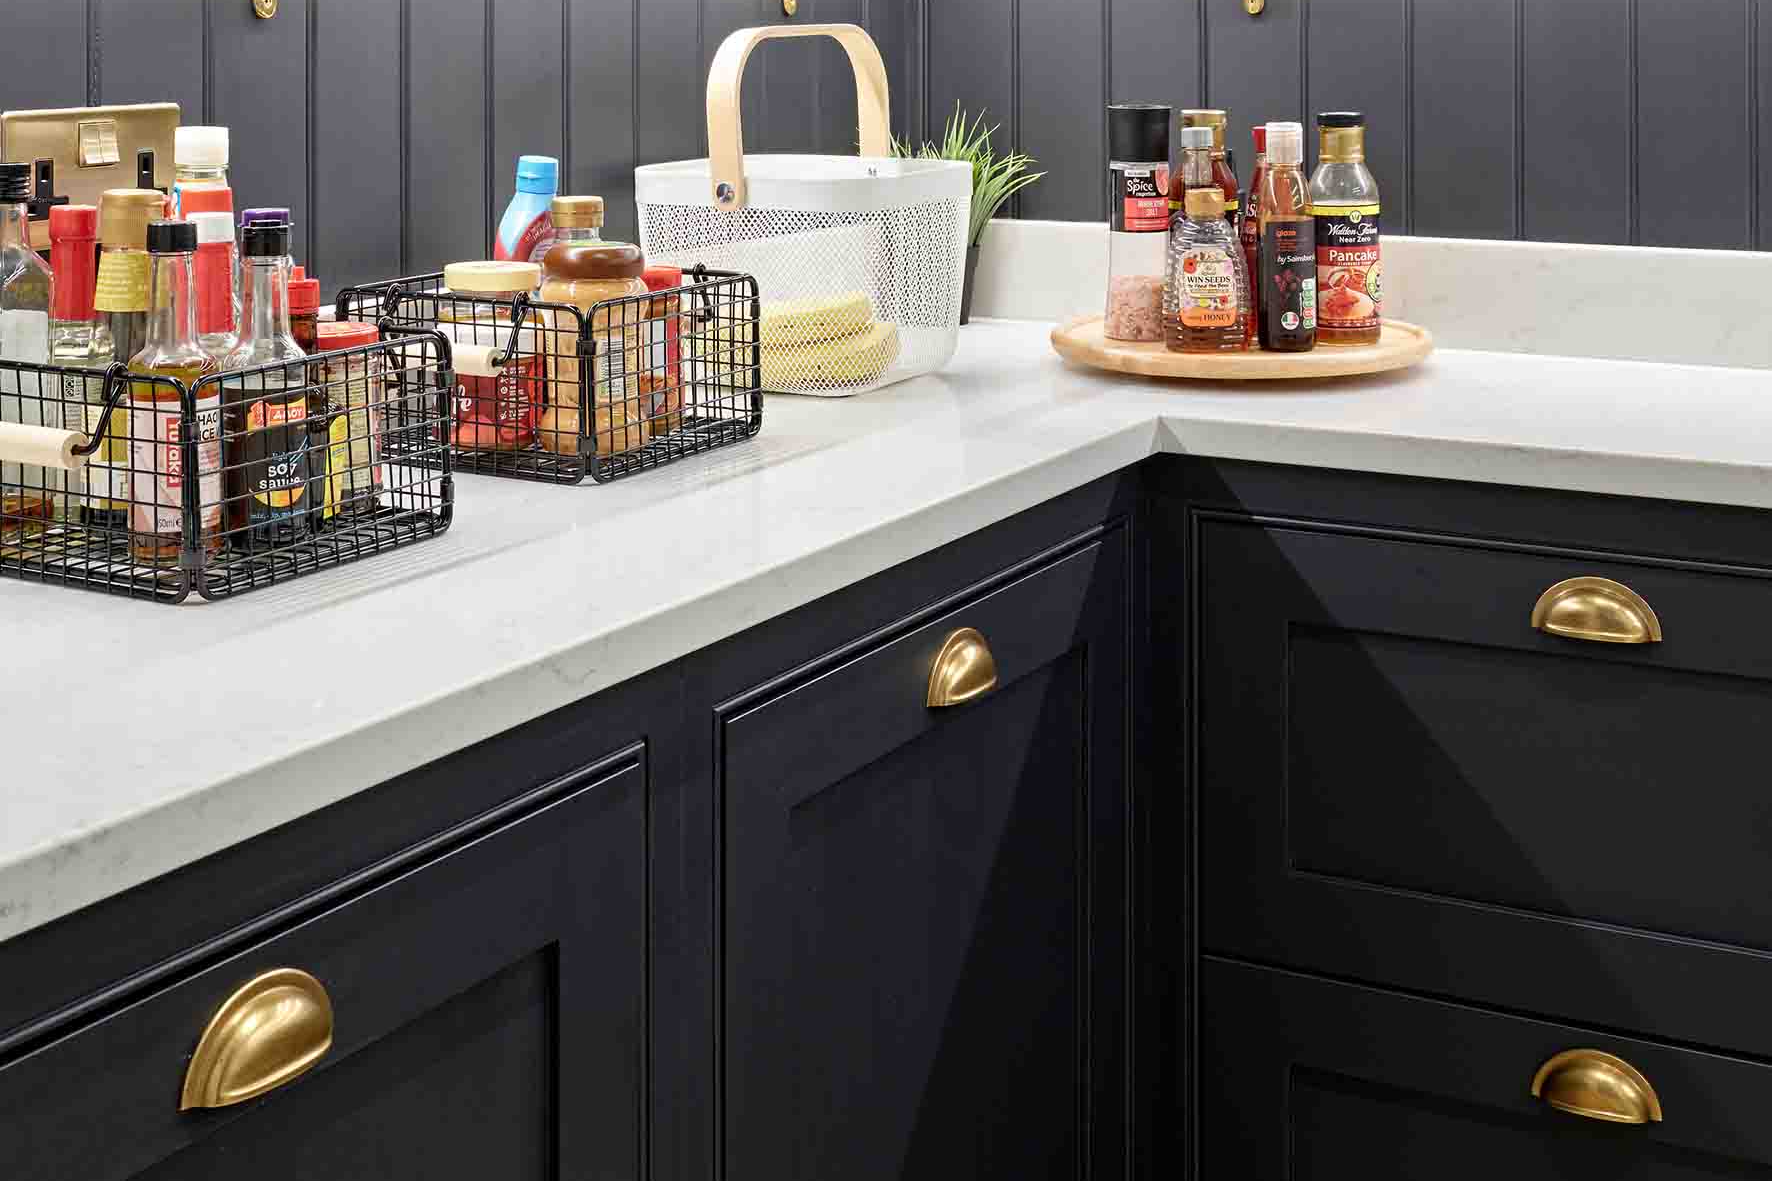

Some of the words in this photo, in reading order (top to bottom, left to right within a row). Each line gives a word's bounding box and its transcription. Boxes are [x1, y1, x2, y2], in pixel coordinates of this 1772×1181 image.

[1127, 179, 1154, 196] Spice
[1327, 223, 1357, 236] Walden
[1339, 236, 1356, 244] Near
[1329, 249, 1377, 262] Pancake
[1187, 276, 1204, 284] WIN
[1204, 275, 1231, 284] SEEDS
